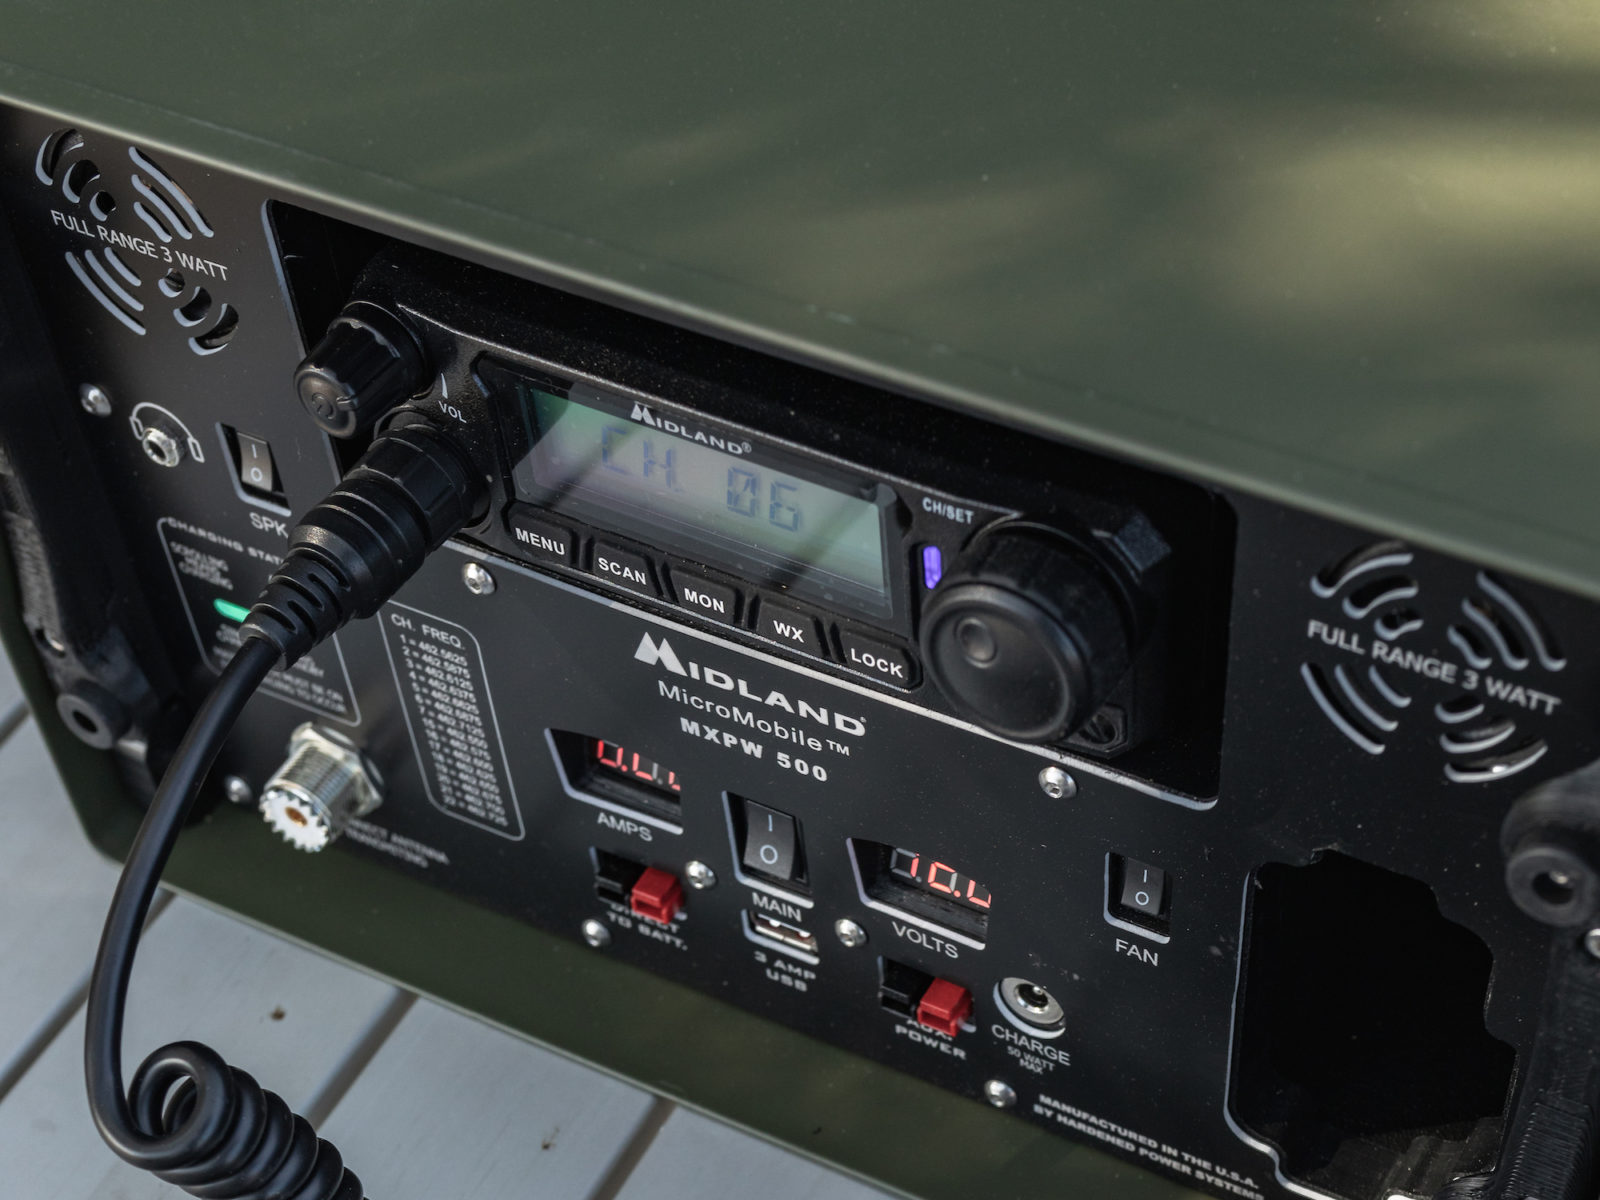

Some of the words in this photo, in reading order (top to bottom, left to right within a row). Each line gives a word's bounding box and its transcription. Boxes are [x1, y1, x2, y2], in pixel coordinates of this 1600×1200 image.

[51, 209, 96, 238] FULL
[96, 224, 159, 259] RANGE
[160, 246, 174, 264] 3
[175, 250, 228, 281] WATT
[438, 400, 467, 424] VOL
[922, 496, 974, 525] CH/SET
[515, 526, 566, 556] MENU
[598, 556, 647, 586] SCAN
[684, 587, 725, 614] MON
[391, 613, 416, 632] CH.
[421, 624, 466, 650] FREQ.
[773, 619, 805, 644] WX
[850, 647, 904, 678] LOCK
[1307, 619, 1366, 656] FULL
[1371, 639, 1457, 684] RANGE
[1461, 670, 1479, 690] 3
[1485, 676, 1562, 716] WATT
[680, 716, 764, 760] MXPW
[776, 751, 829, 782] 500
[597, 811, 653, 842] AMPS
[606, 910, 633, 930] TO
[752, 891, 802, 923] MAIN
[892, 921, 959, 959] VOLTS
[1115, 938, 1159, 967] FAN
[765, 967, 808, 993] USB
[773, 958, 817, 980] AMP
[895, 1023, 967, 1061] POWER
[991, 1024, 1071, 1067] CHARGE
[1007, 1045, 1021, 1059] 50
[1023, 1052, 1056, 1072] WATT
[1019, 1059, 1044, 1075] MAX
[1033, 1103, 1054, 1118] BY
[1057, 1112, 1136, 1153] HARDENED
[1138, 1147, 1192, 1176] POWER
[1038, 1093, 1159, 1150] MANUFACTURED
[1161, 1143, 1178, 1158] IN
[1181, 1151, 1213, 1171] THE
[1215, 1165, 1259, 1190] U.S.A.
